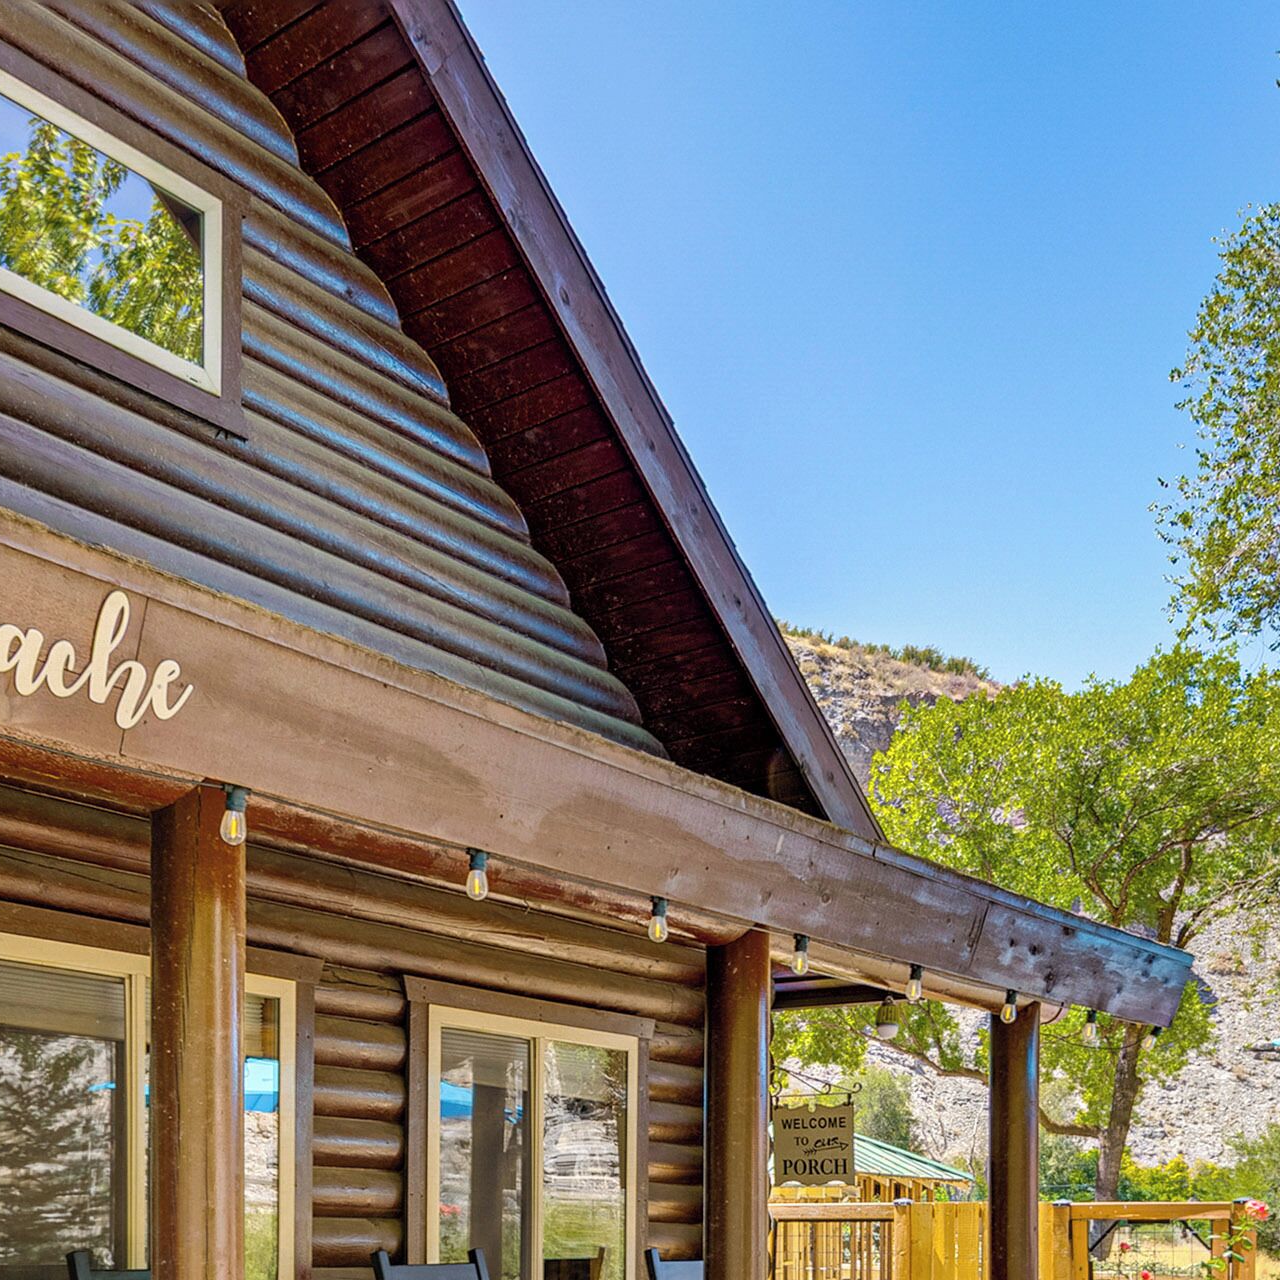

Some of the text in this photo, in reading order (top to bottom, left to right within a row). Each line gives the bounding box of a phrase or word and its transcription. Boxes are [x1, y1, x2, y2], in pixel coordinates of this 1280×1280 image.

[781, 1117, 847, 1129] WELCOME
[794, 1136, 809, 1146] TO
[783, 1158, 848, 1175] PORCH
